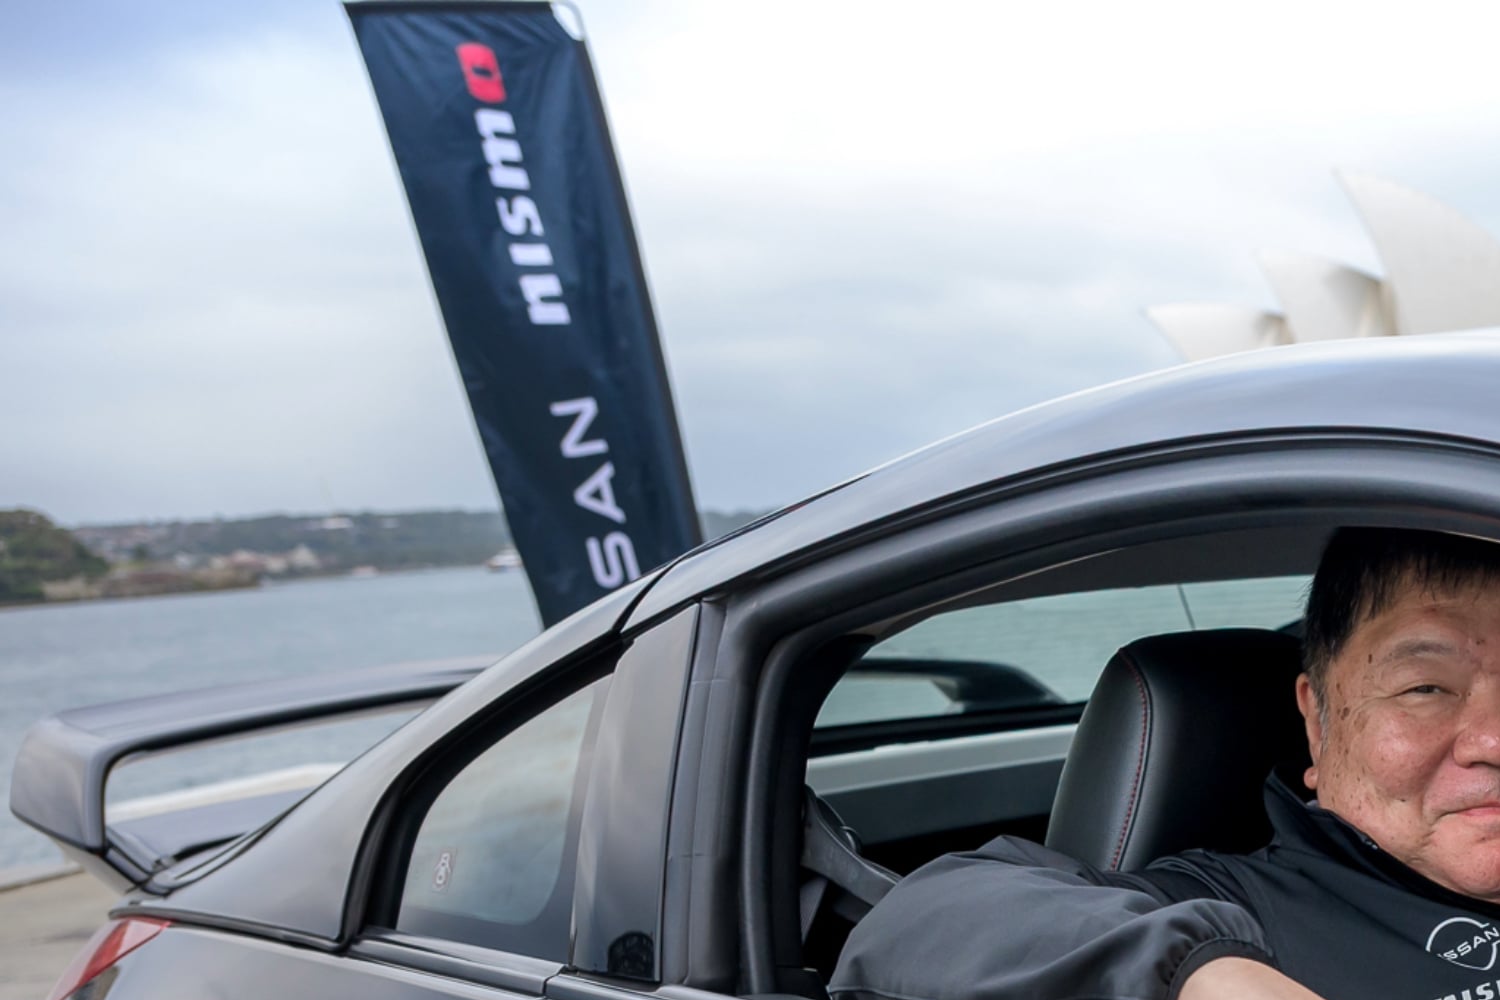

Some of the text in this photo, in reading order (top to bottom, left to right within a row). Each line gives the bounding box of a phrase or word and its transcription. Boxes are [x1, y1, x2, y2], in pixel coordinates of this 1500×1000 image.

[456, 42, 571, 326] nismo
[550, 397, 641, 589] SAN
[1441, 926, 1500, 960] SSAN
